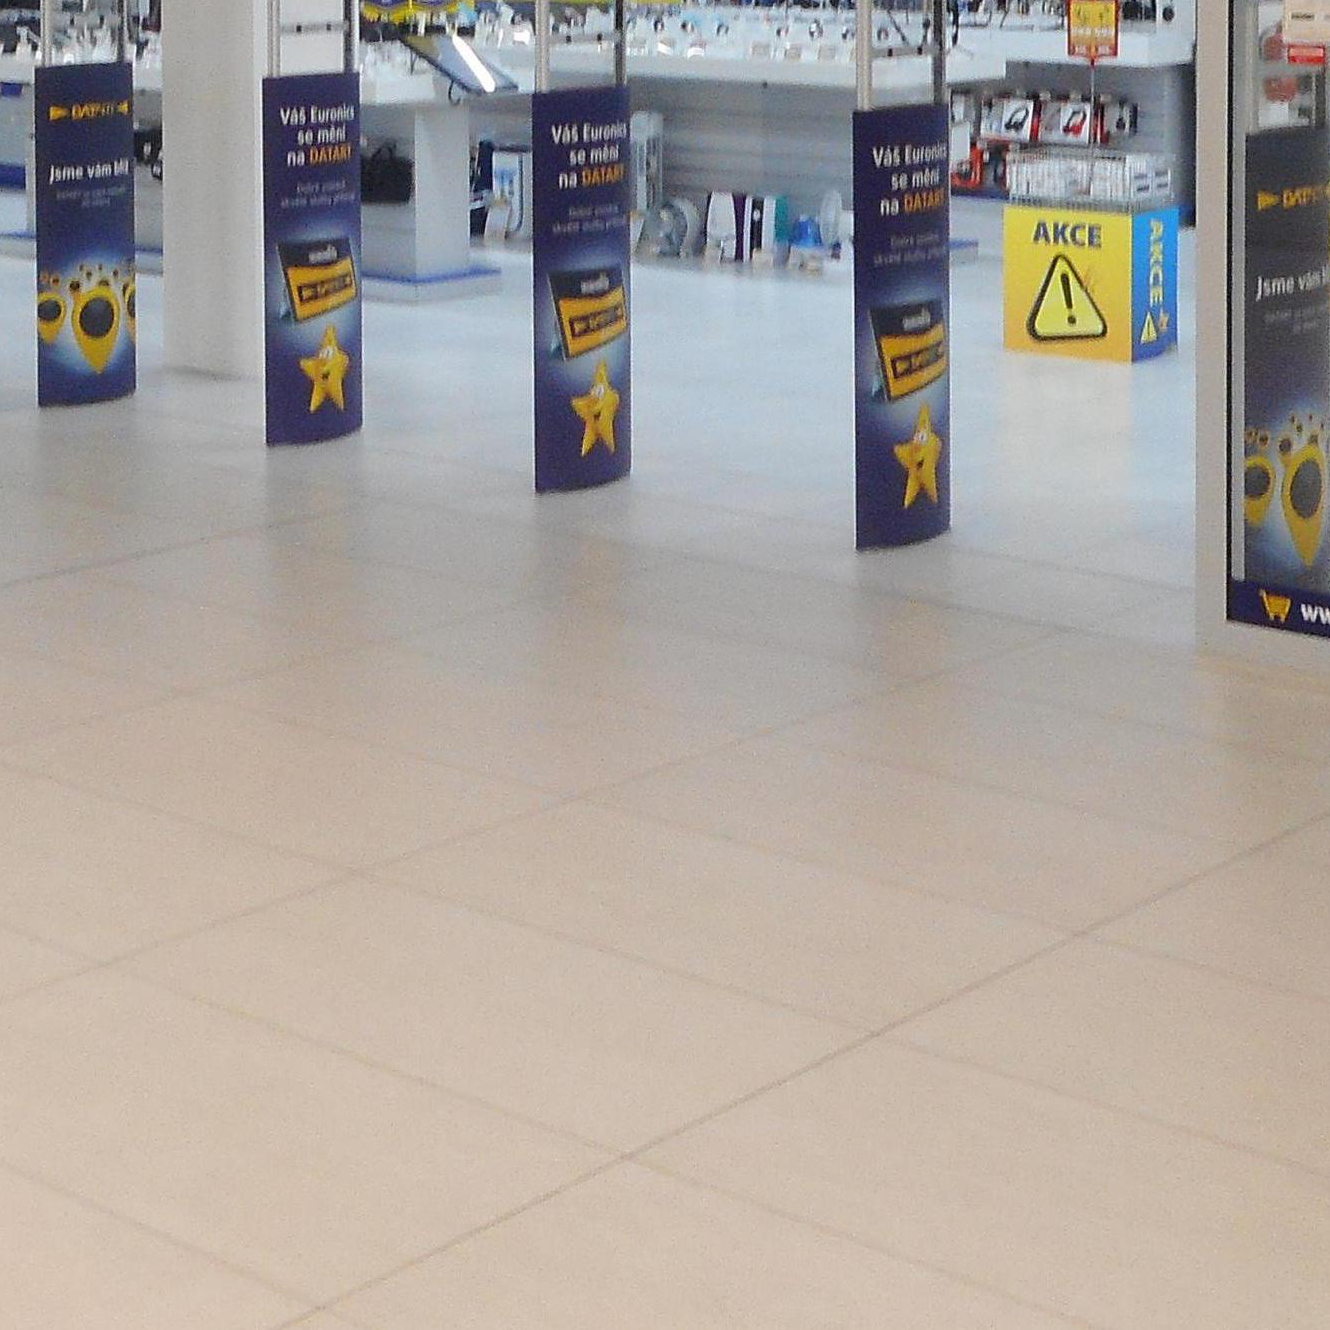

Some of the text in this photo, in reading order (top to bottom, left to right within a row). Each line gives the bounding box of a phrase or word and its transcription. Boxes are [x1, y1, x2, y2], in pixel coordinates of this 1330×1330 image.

[279, 105, 306, 126] Váš
[297, 121, 346, 146] se mění
[552, 123, 579, 145] Váš
[287, 150, 306, 166] na
[570, 148, 587, 166] se
[873, 145, 901, 168] Váš
[50, 164, 84, 186] Jsme
[87, 161, 112, 179] vám
[558, 171, 578, 189] na
[891, 172, 908, 190] se
[880, 198, 899, 216] na
[1032, 220, 1103, 249] AKCE
[1150, 219, 1164, 307] AKCE
[1255, 275, 1295, 302] Jsme
